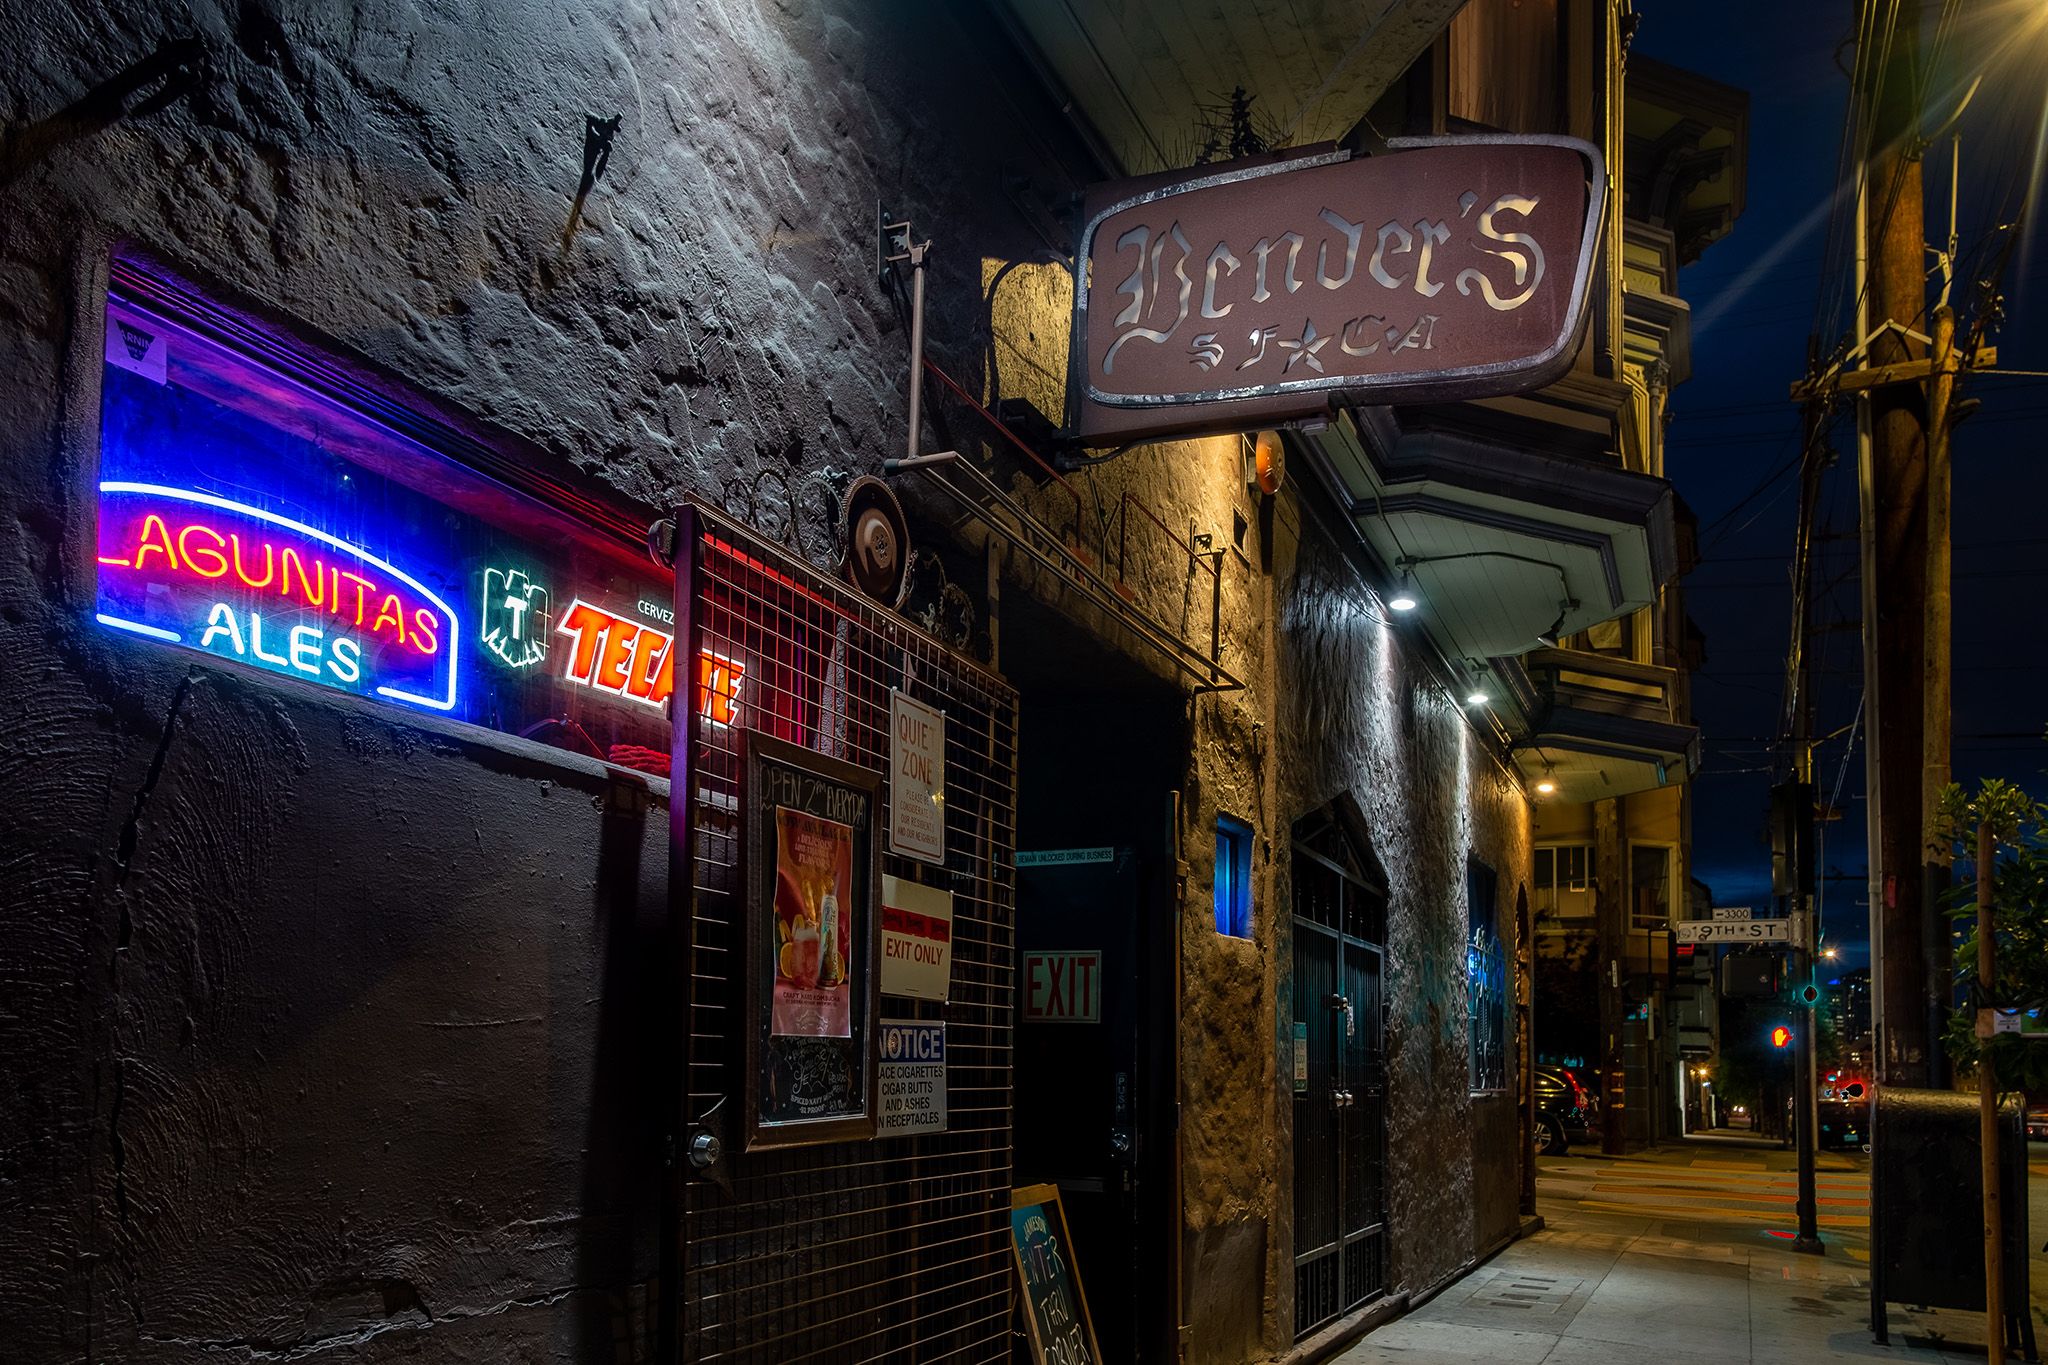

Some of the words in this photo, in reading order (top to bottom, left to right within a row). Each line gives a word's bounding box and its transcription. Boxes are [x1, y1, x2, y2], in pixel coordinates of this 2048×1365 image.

[638, 599, 674, 625] CERVEZ
[201, 602, 361, 683] ALES
[899, 713, 936, 752] QUIET
[901, 748, 933, 786] ZONE
[760, 763, 801, 808] OPEN
[906, 788, 923, 804] PLEASE
[900, 800, 929, 819] CONSIDERATE
[900, 813, 910, 825] OUR
[910, 815, 935, 832] RESIDENTS
[897, 825, 906, 837] AND
[906, 827, 915, 839] OUR
[915, 830, 938, 847] NEIGHBORS
[1018, 854, 1037, 863] REMAIN
[1038, 852, 1065, 863] UNLOCKED
[1066, 851, 1085, 862] DURING
[1087, 850, 1113, 860] BUSINESS
[1724, 909, 1749, 919] 3300
[1692, 925, 1735, 940] 19TH
[1750, 924, 1777, 937] ST
[886, 937, 912, 960] EXIT
[914, 943, 943, 966] ONLY
[1027, 957, 1097, 1017] EXIT
[879, 1028, 941, 1060] NOTICE
[878, 1066, 895, 1079] ACE
[897, 1065, 944, 1079] CIGARETTES
[882, 1082, 906, 1095] CIGAR
[908, 1081, 933, 1094] BUTTS
[885, 1098, 902, 1112] AND
[904, 1096, 930, 1111] ASHES
[878, 1116, 884, 1129] N
[886, 1111, 939, 1128] RECEPTACLES
[1023, 1215, 1047, 1242] JAMESON
[1040, 1284, 1069, 1336] THRU
